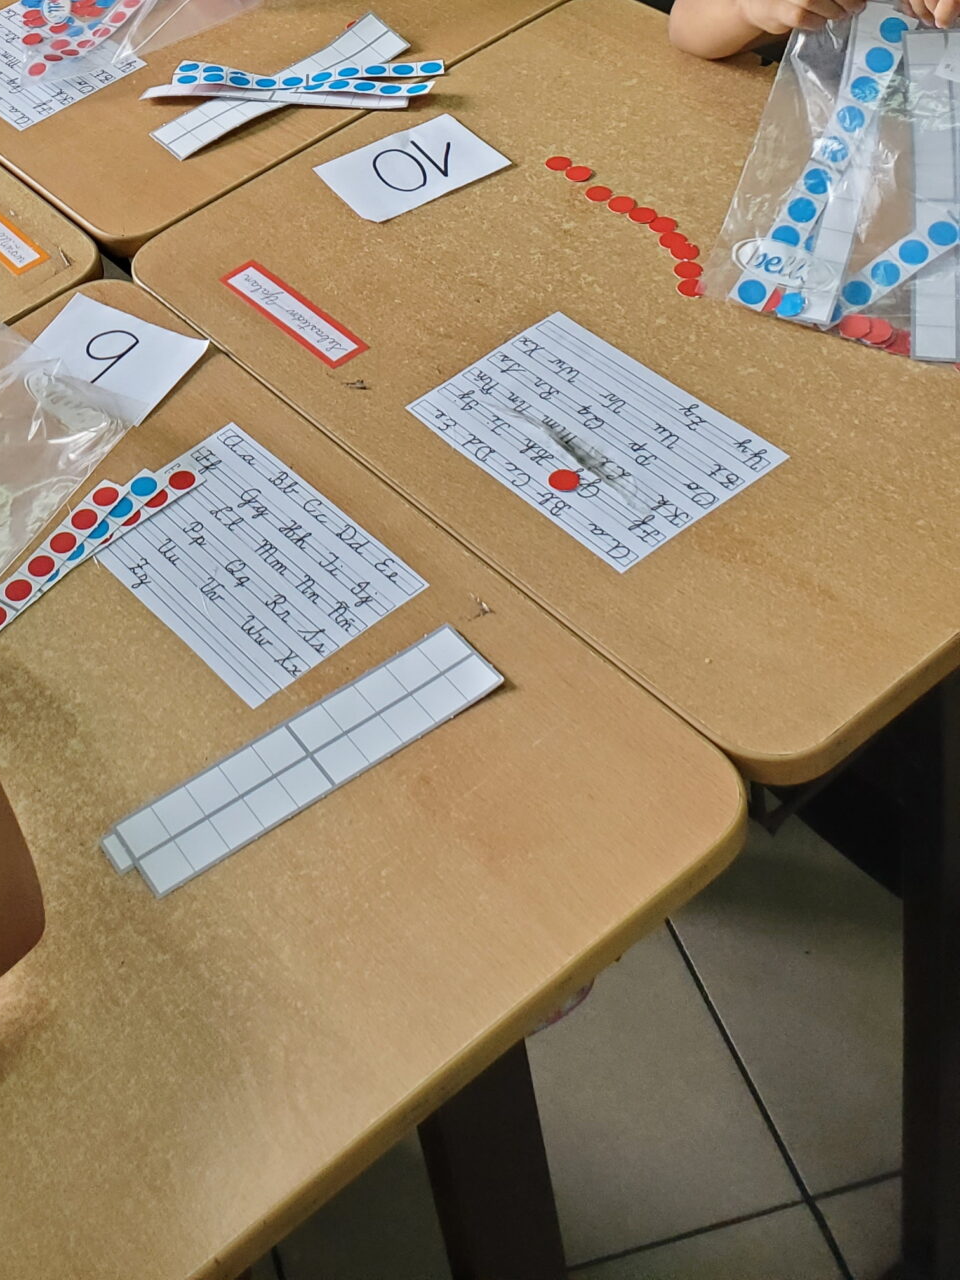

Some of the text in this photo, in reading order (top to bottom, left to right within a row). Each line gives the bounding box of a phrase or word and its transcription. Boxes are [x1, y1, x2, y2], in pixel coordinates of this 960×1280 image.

[372, 140, 452, 193] 10
[86, 329, 140, 384] 9
[654, 422, 680, 450] Uu
[223, 434, 398, 584] Aa Bb Cc Dd Ee
[435, 409, 631, 559] Aa Bb Cc Dd Ee
[683, 481, 716, 507] Oo
[182, 521, 207, 547] Pp
[157, 538, 180, 567] Uu
[240, 615, 273, 647] Ww
[254, 538, 288, 577] Mm
[295, 574, 320, 605] Nn
